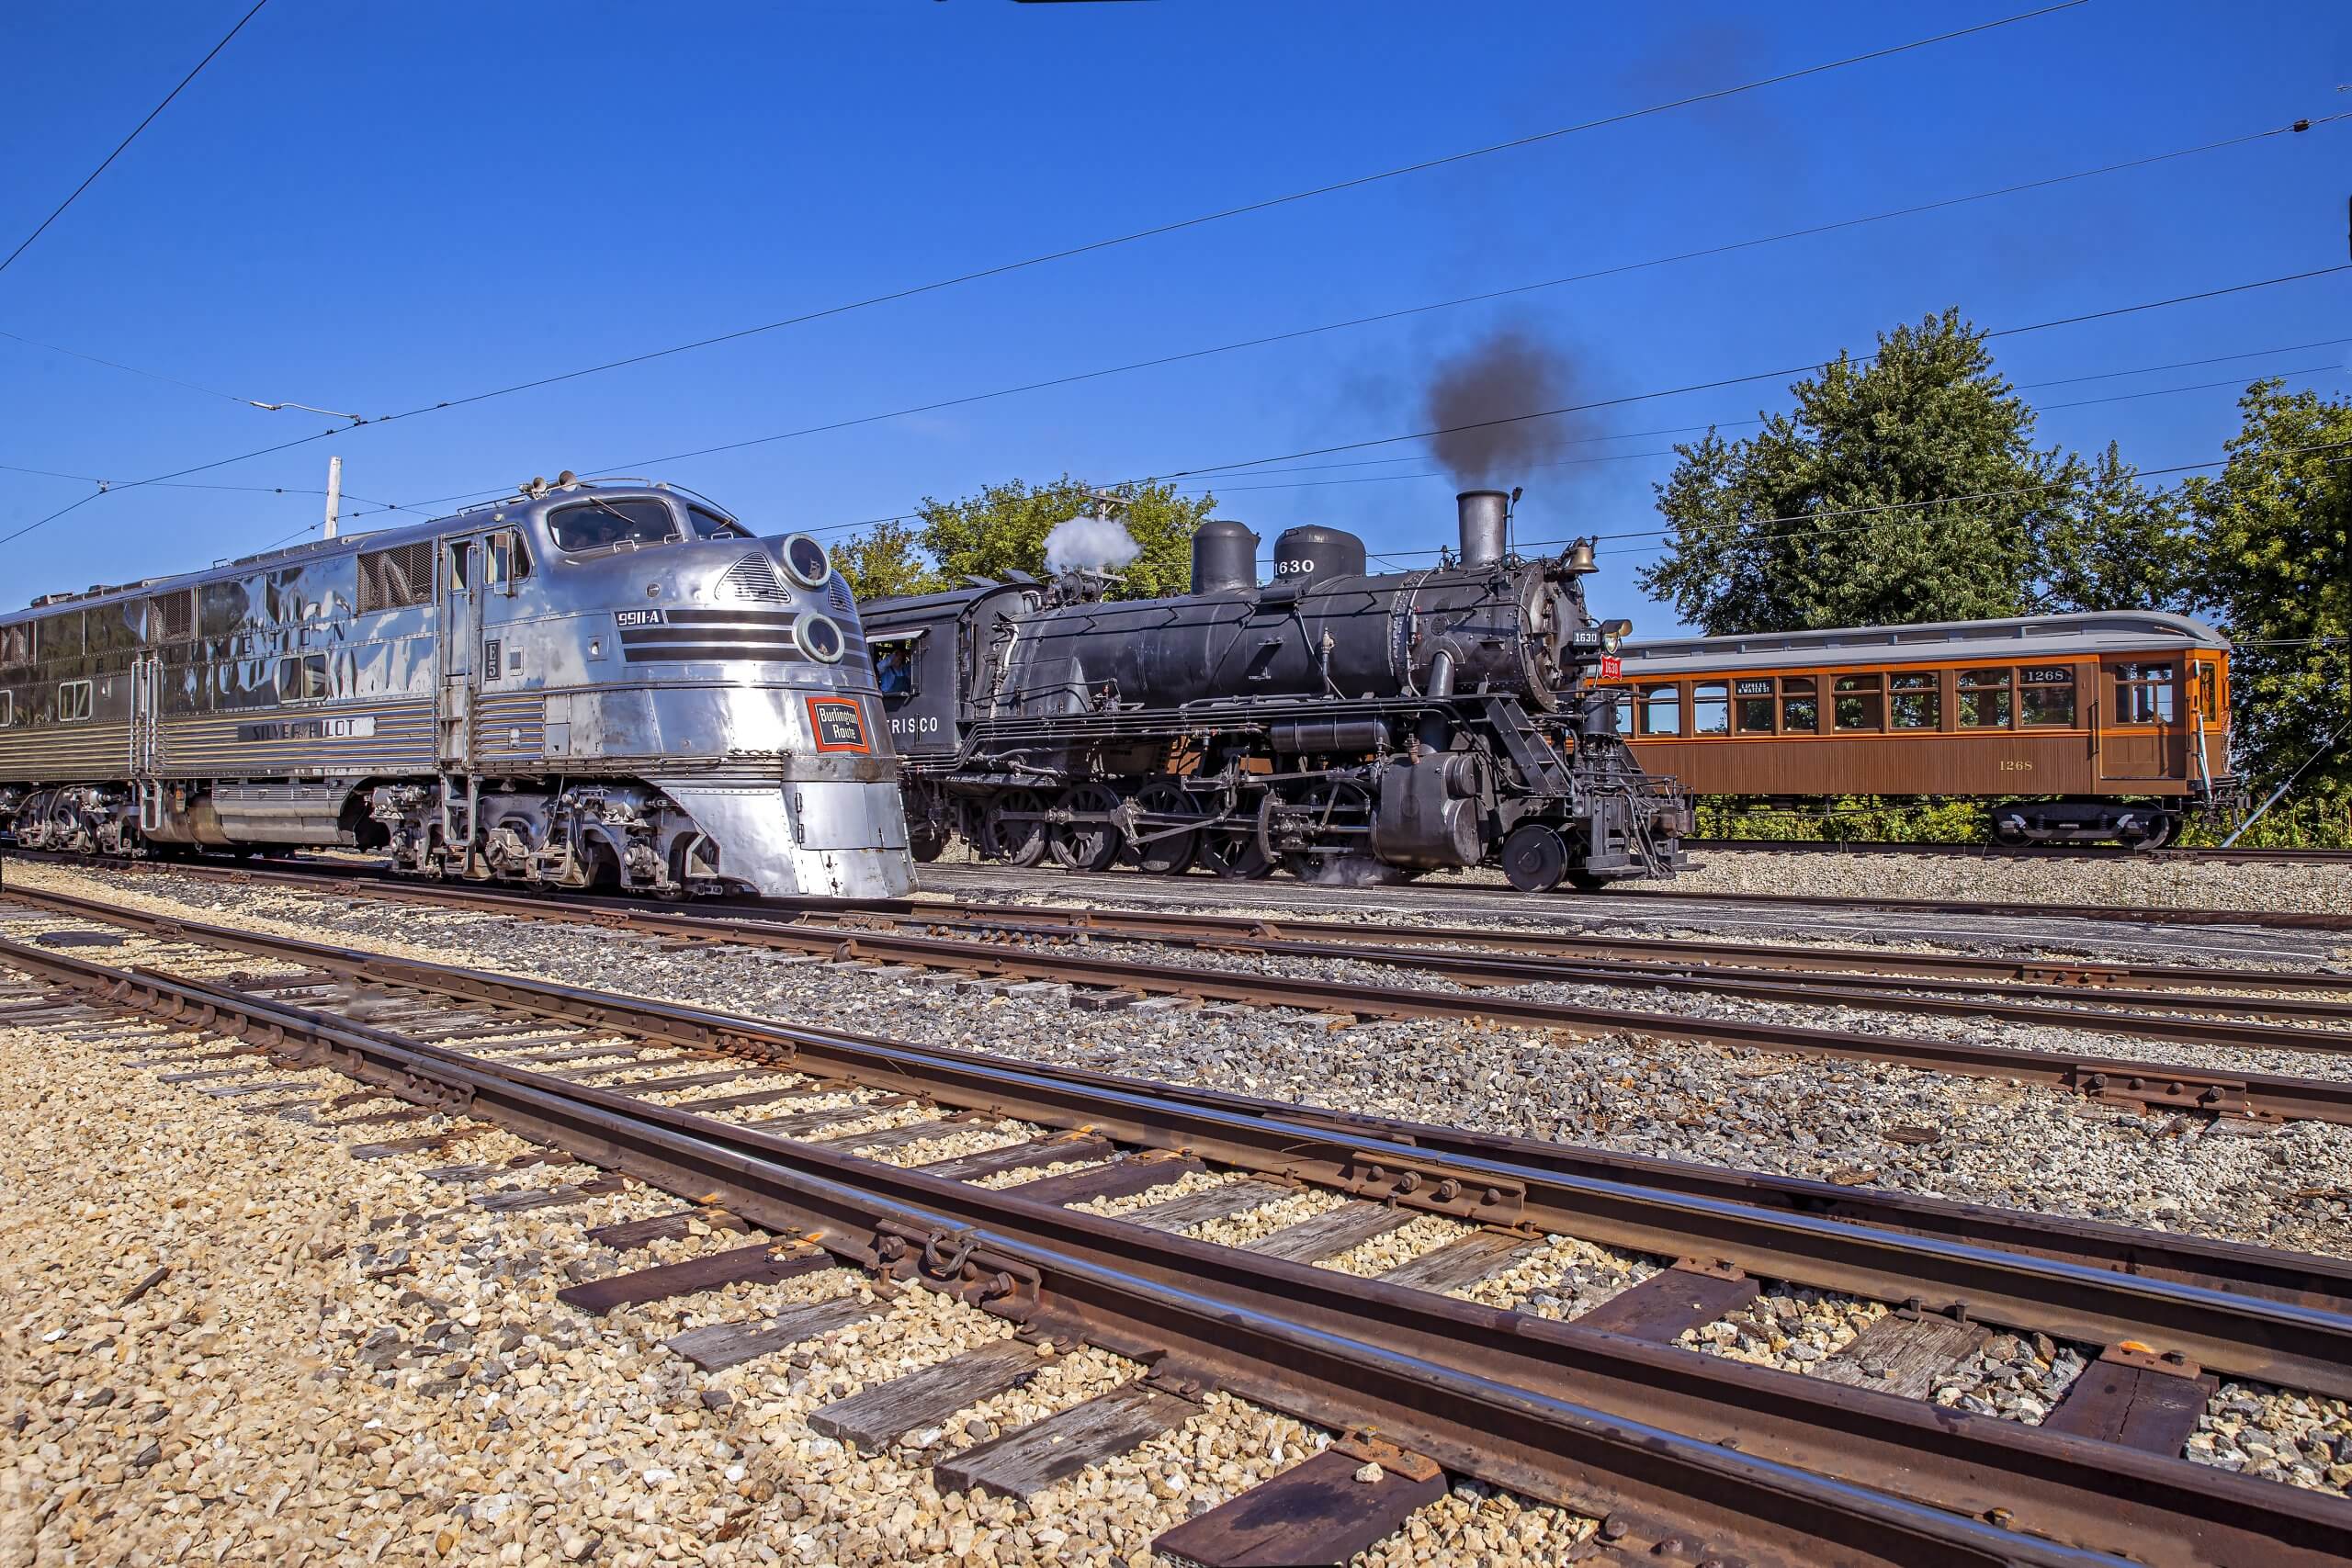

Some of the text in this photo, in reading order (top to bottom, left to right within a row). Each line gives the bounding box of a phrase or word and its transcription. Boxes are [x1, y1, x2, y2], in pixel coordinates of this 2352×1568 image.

[618, 611, 660, 626] 9911-A
[1575, 633, 1597, 642] 1630
[1605, 660, 1619, 675] 1630
[2028, 671, 2064, 682] 1268
[819, 707, 858, 726] Burlington
[832, 724, 856, 739] Route
[887, 716, 938, 734] RISCO
[1999, 761, 2033, 771] 1268
